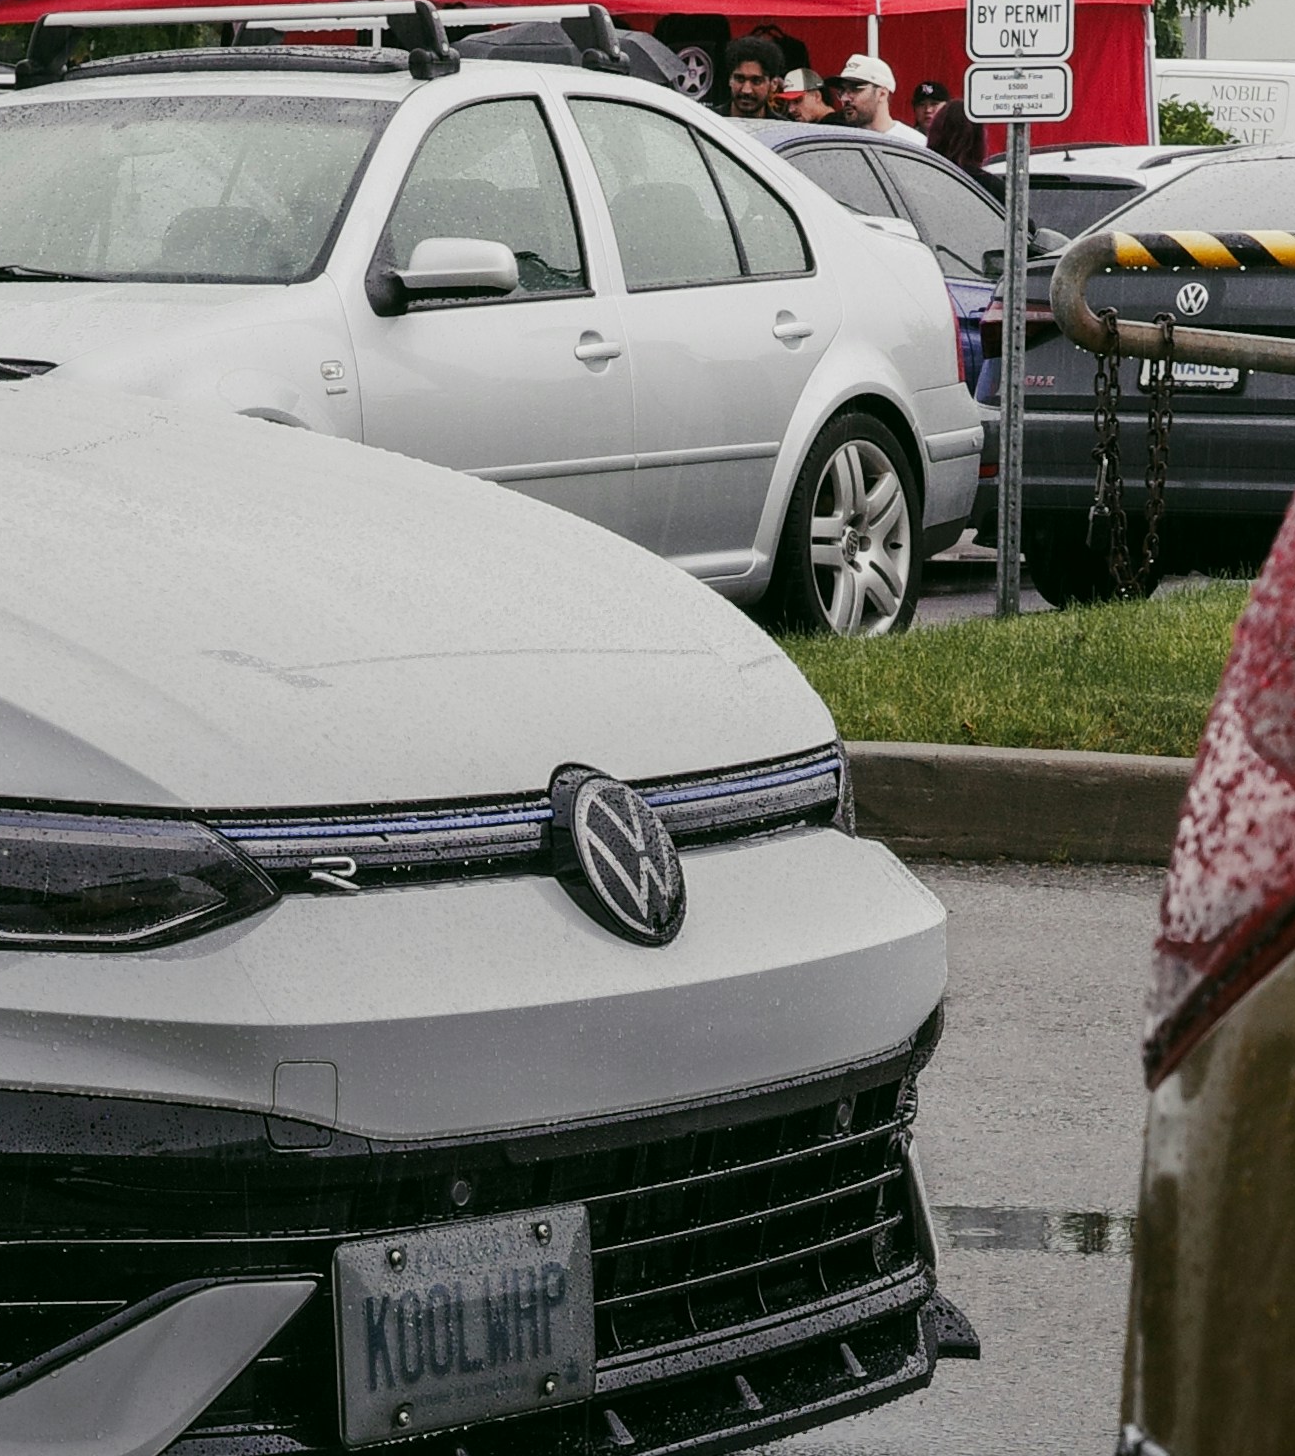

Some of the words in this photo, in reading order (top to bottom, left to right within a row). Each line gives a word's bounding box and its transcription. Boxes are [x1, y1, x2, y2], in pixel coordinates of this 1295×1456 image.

[978, 6, 997, 23] BY
[1005, 4, 1061, 23] PERMIT
[1000, 29, 1038, 47] ONLY
[1211, 85, 1278, 102] MOBILE
